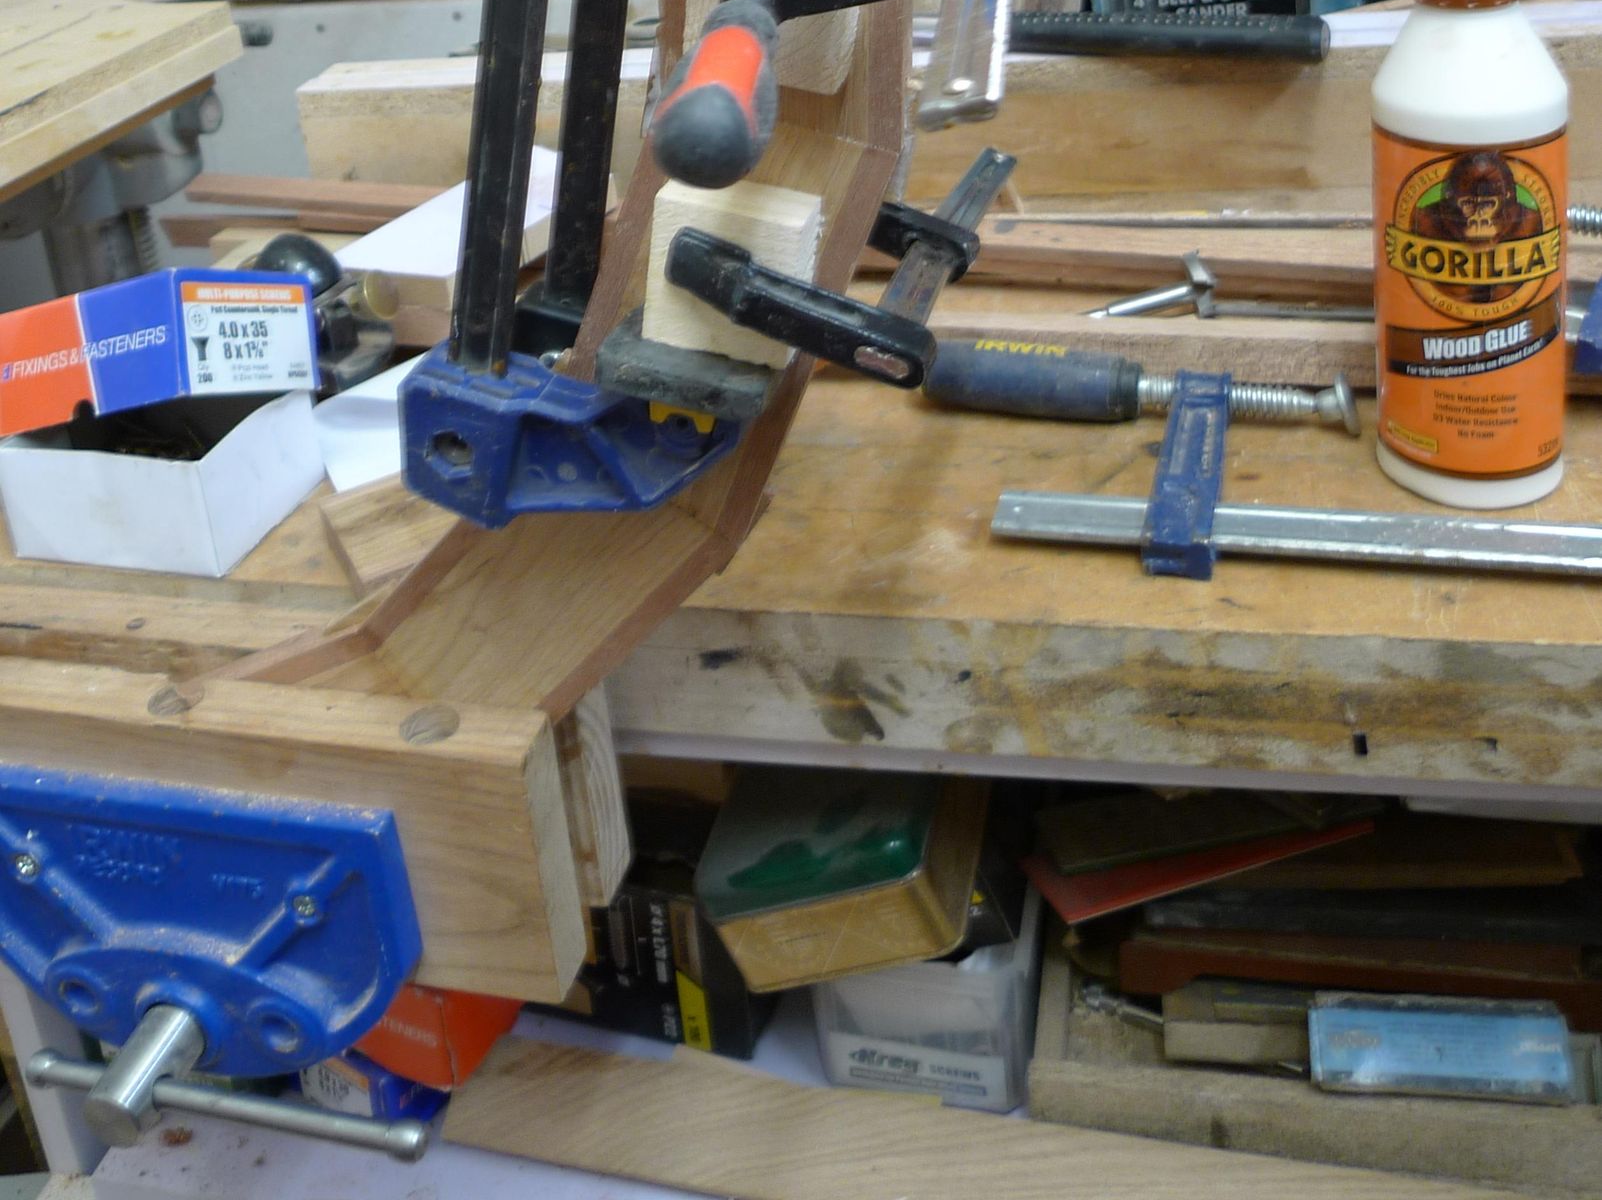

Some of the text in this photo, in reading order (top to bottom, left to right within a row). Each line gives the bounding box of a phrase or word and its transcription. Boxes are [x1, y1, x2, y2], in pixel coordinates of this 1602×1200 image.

[1175, 2, 1248, 17] SANDER
[1400, 240, 1548, 280] GORILLA
[1472, 295, 1520, 318] TOUGH
[218, 320, 268, 339] 4.0 x 35
[1484, 319, 1532, 353] GLUE
[12, 323, 168, 380] FIXINGS & FASTENERS
[223, 341, 233, 360] 8
[234, 343, 244, 360] x
[974, 338, 1068, 358] IRWIN
[1405, 364, 1418, 375] For
[1418, 365, 1431, 377] the
[1431, 365, 1466, 378] Toughest
[1467, 362, 1485, 375] Jobs
[1486, 360, 1497, 370] on
[1497, 349, 1523, 368] Planet
[1457, 391, 1489, 403] Natural
[1445, 415, 1472, 426] Water
[1472, 416, 1519, 427] Resistance
[1470, 429, 1495, 440] Foam
[380, 1014, 438, 1048] TENERS
